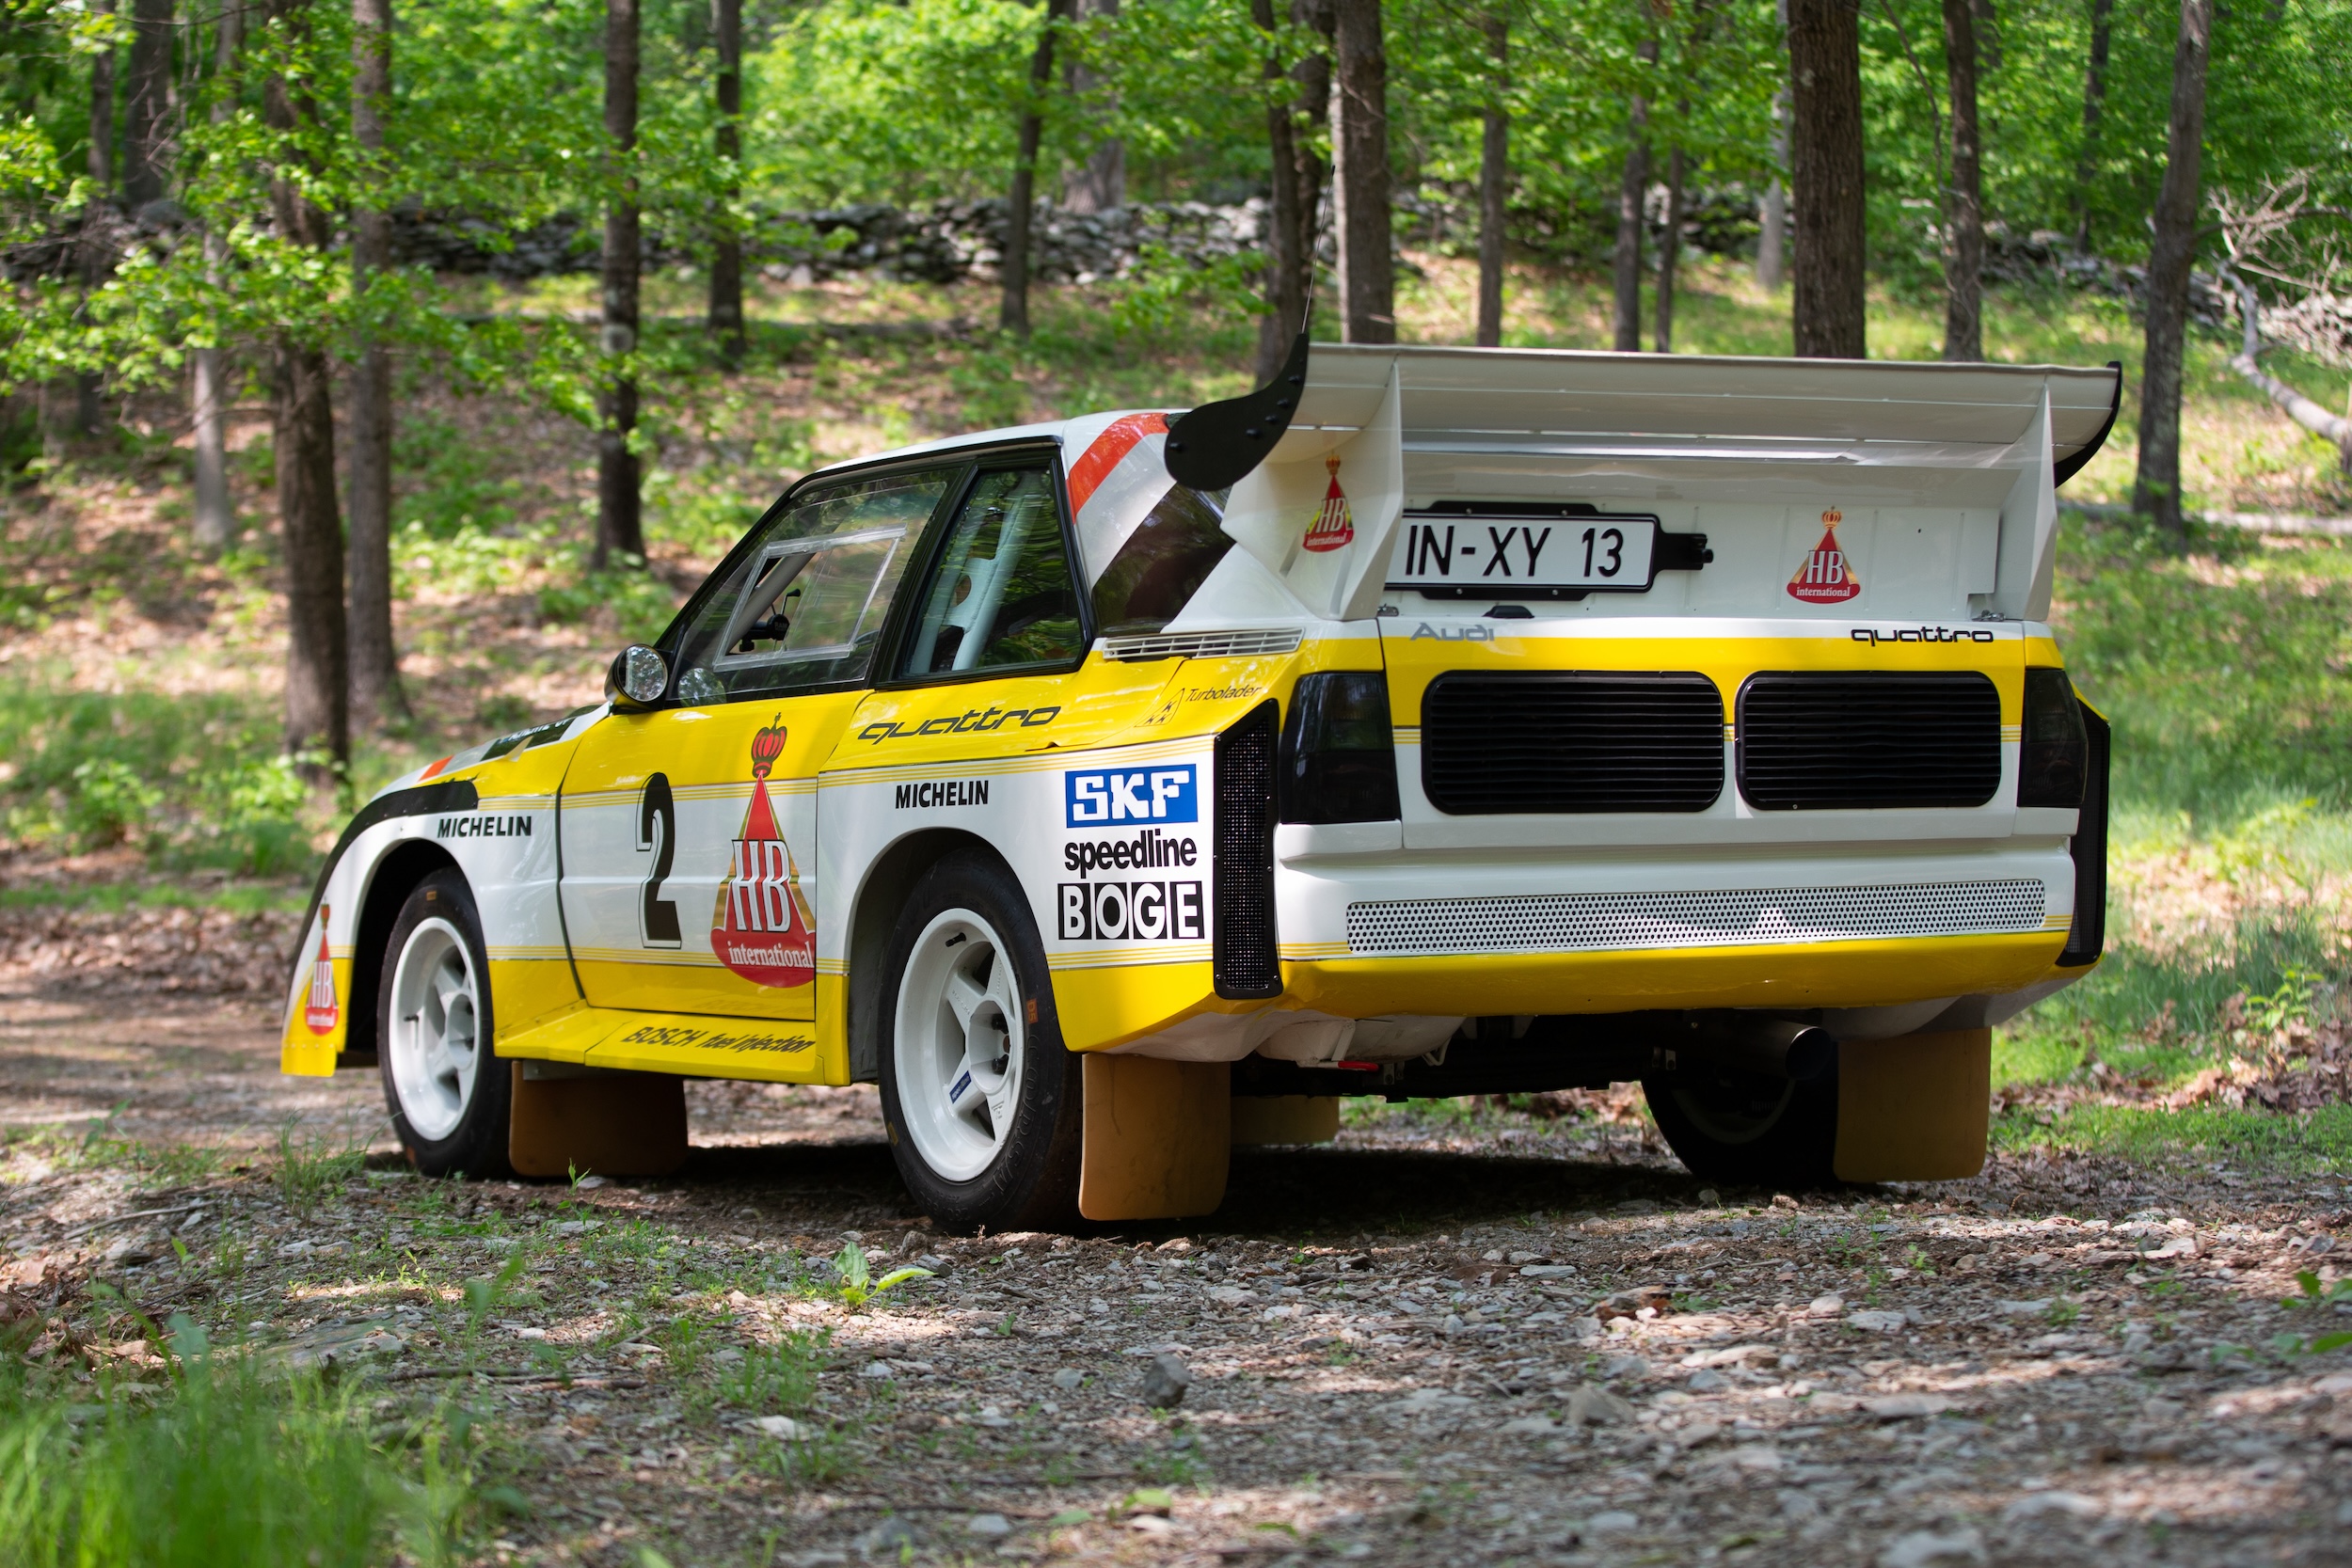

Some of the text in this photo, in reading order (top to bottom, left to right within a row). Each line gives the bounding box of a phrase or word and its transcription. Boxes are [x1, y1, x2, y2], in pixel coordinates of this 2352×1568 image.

[1315, 498, 1346, 533] HB
[1306, 531, 1348, 546] international
[1405, 525, 1624, 578] IN-XY 13
[1806, 550, 1844, 584] HB
[1796, 586, 1851, 597] international
[1409, 623, 1495, 641] Audi
[1851, 626, 1994, 647] quattro
[1185, 685, 1263, 703] Turbolader
[857, 705, 1061, 745] quattro
[895, 780, 990, 809] MICHELIN
[1073, 770, 1190, 821] SKF
[437, 816, 532, 839] MICHELIN
[636, 772, 682, 949] 2
[1064, 829, 1198, 879] speedline
[731, 839, 791, 932] HB
[1059, 881, 1203, 940] BOGE
[728, 941, 815, 968] international
[312, 961, 331, 1008] HB
[621, 1026, 709, 1047] BOSCH
